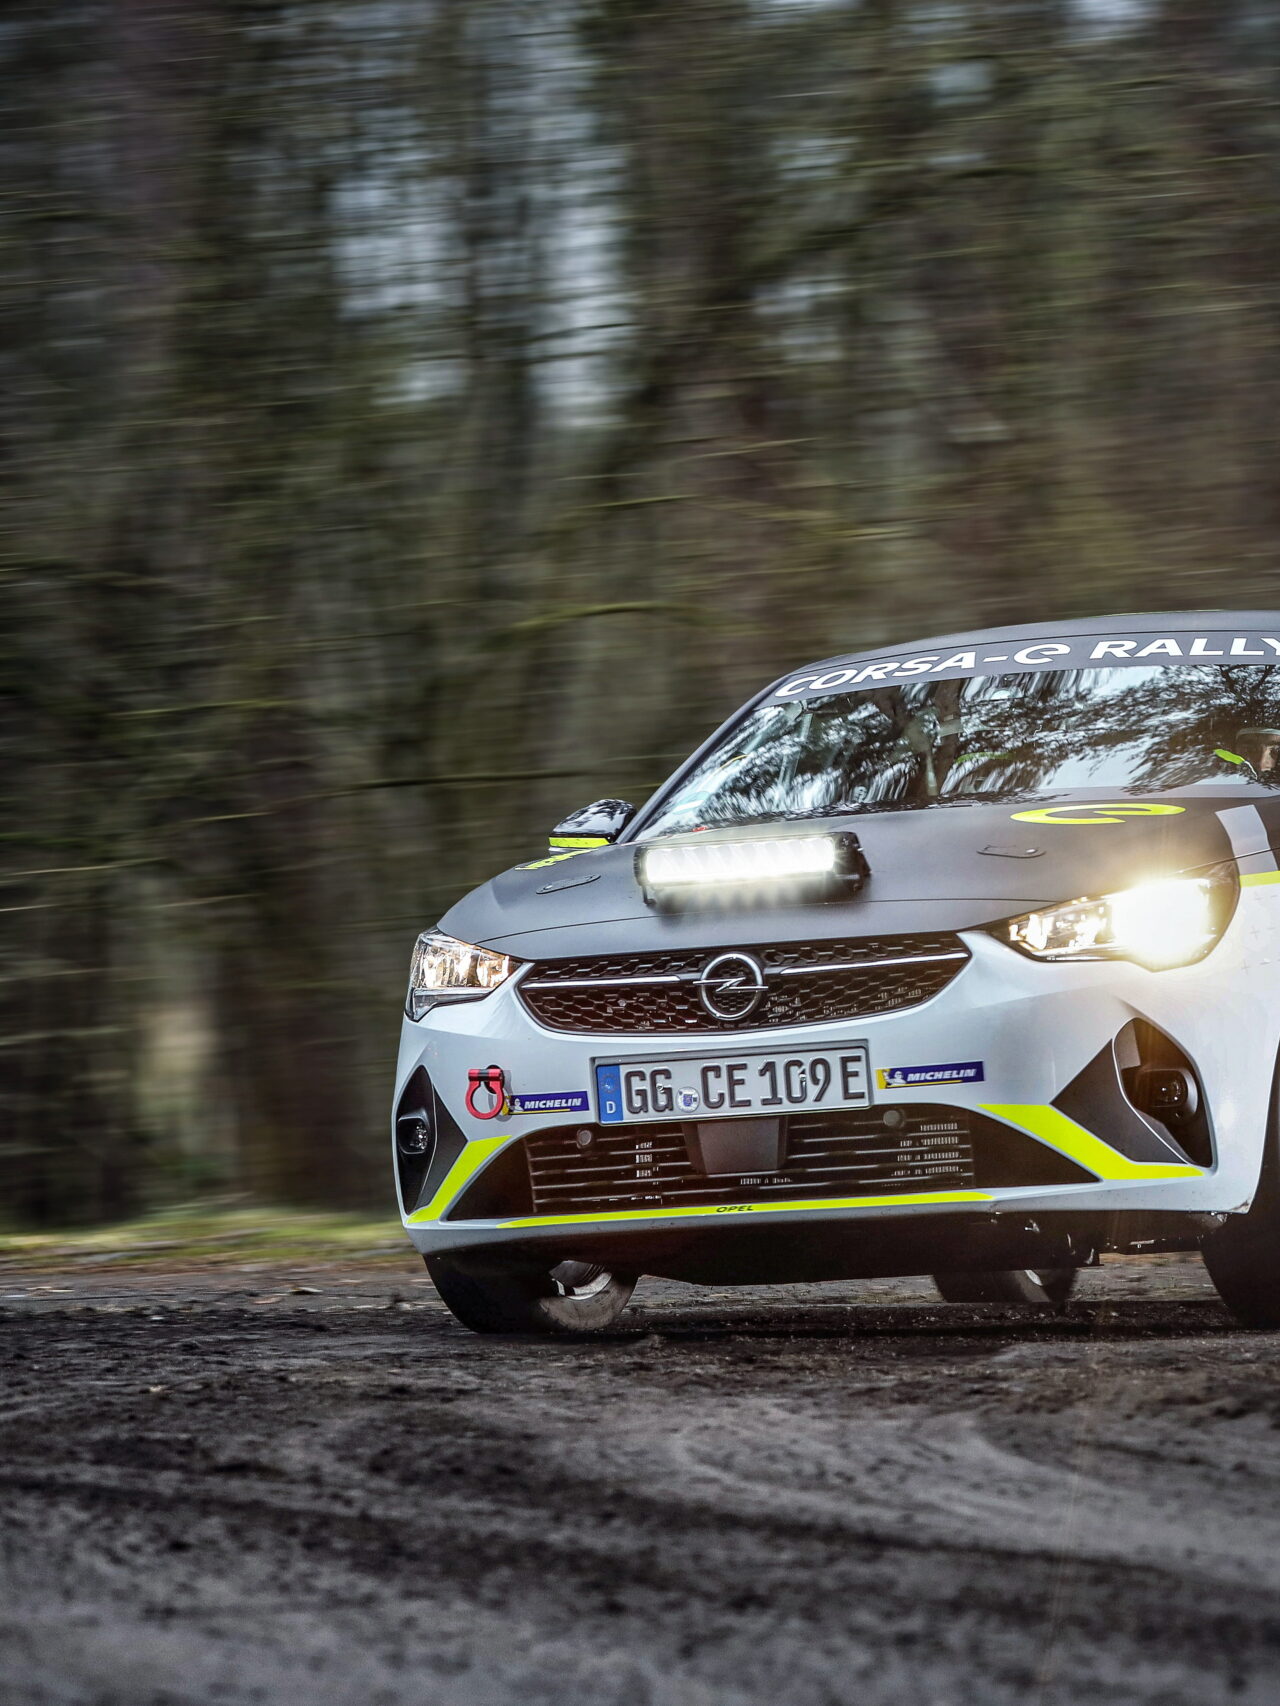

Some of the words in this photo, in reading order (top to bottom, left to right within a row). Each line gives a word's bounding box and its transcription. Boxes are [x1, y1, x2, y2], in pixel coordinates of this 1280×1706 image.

[906, 1068, 977, 1082] MICHELIN
[624, 1068, 674, 1115] GG
[700, 1062, 751, 1110] CE
[523, 1098, 582, 1110] MICHELIN
[606, 1101, 617, 1114] D
[716, 1205, 754, 1213] OPEL
